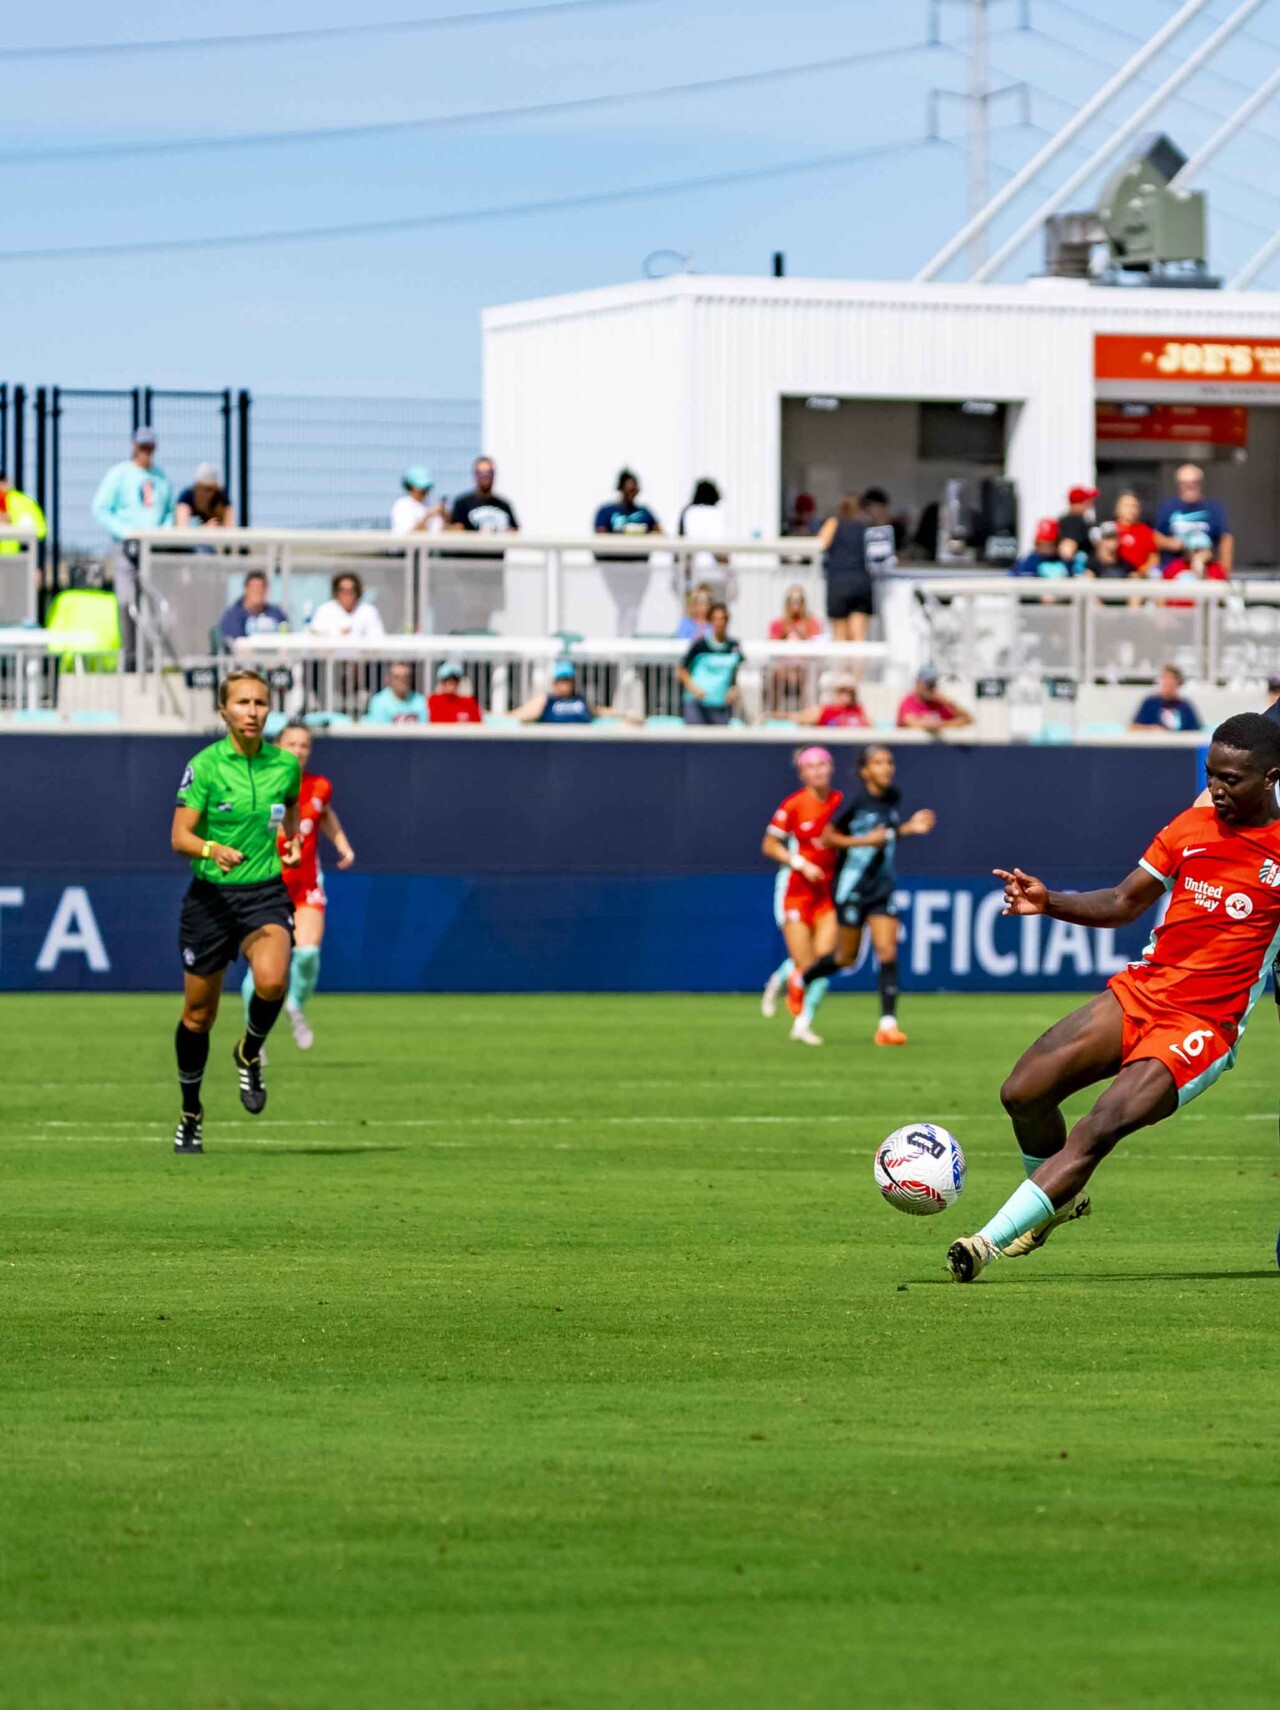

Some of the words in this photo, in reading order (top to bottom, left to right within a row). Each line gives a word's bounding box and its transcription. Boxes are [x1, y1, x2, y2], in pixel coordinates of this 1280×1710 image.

[1157, 343, 1252, 374] JOE'S
[1184, 876, 1224, 900] United
[1194, 892, 1220, 913] Way
[1183, 1029, 1215, 1057] 6
